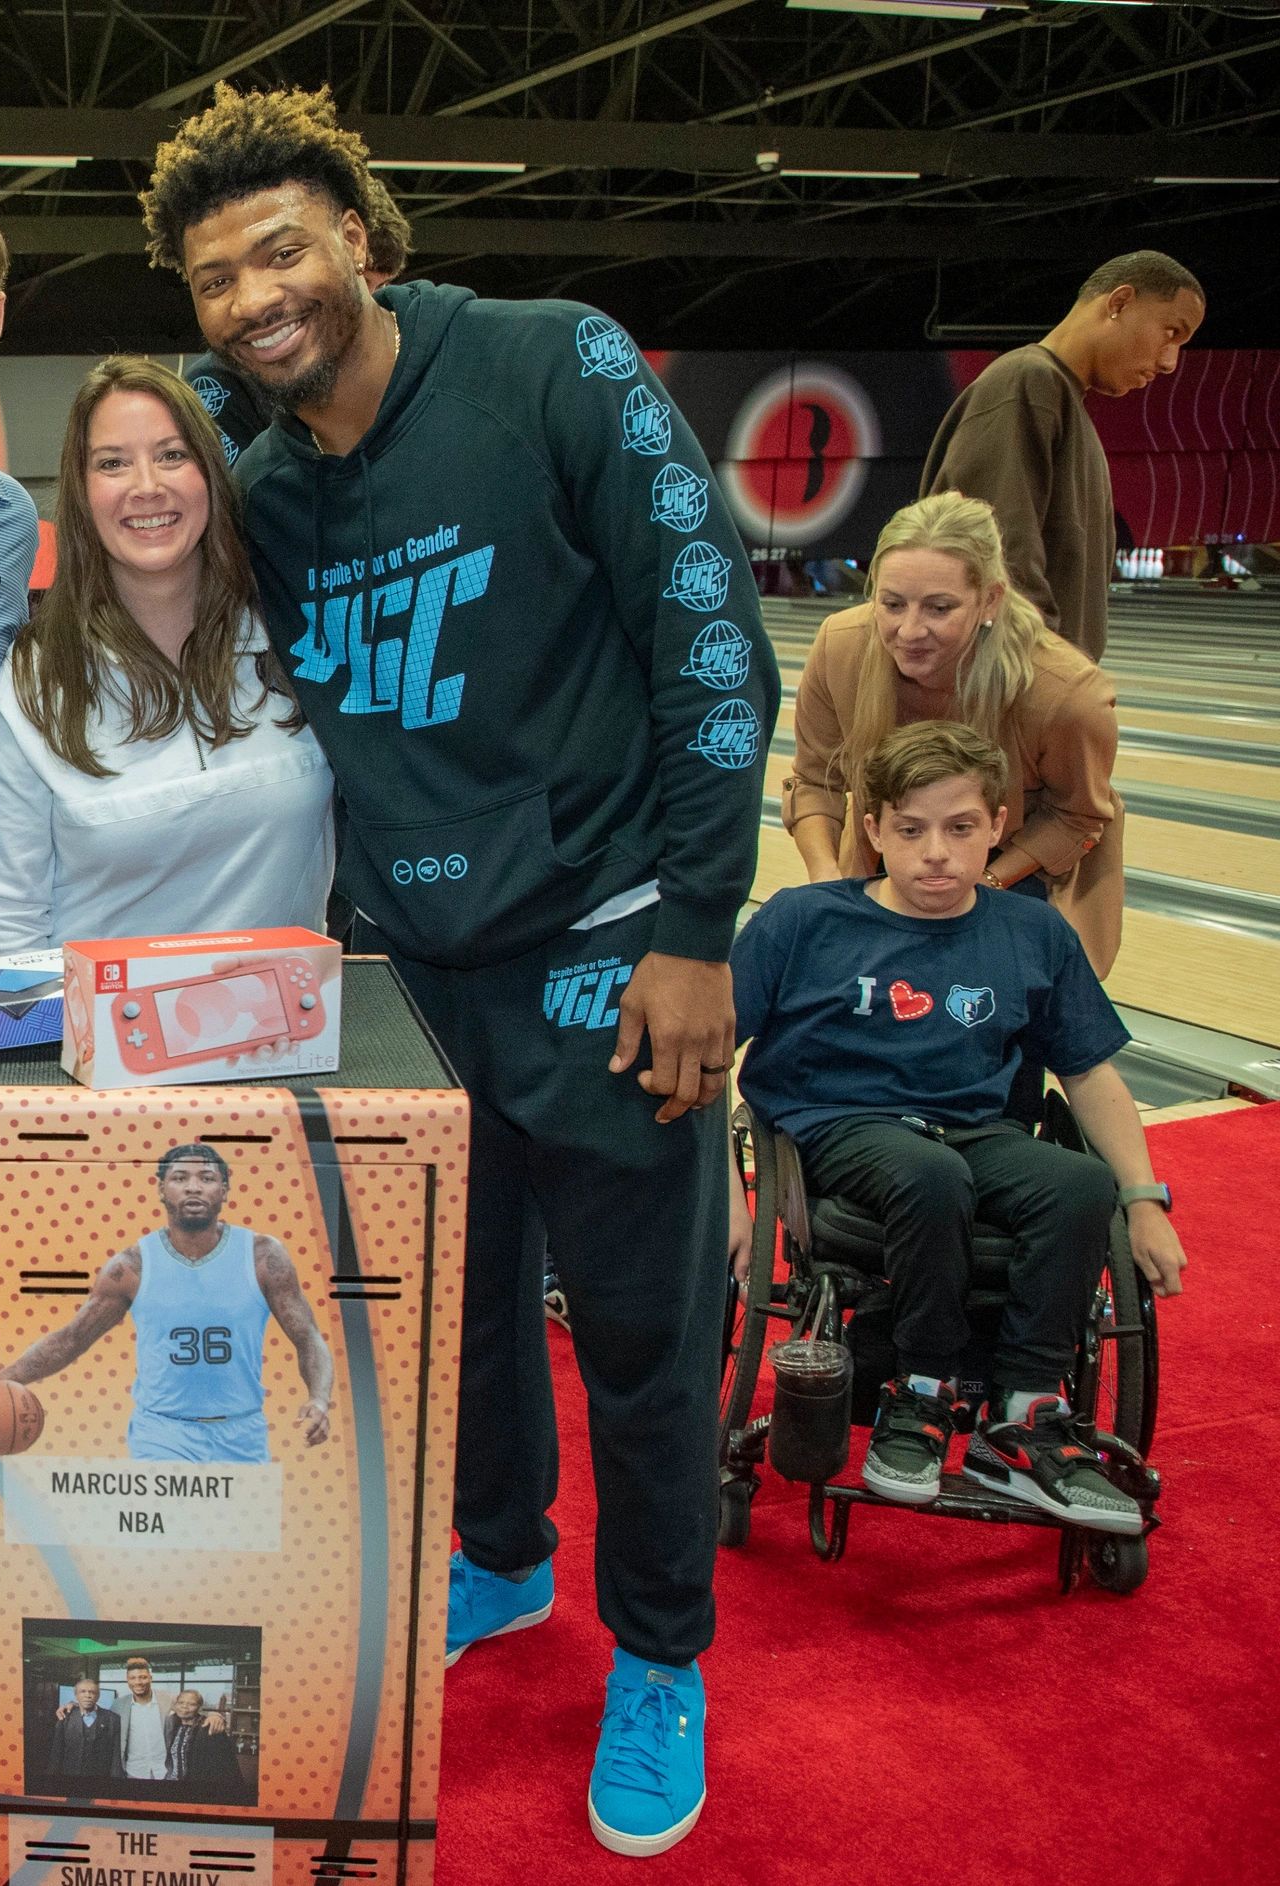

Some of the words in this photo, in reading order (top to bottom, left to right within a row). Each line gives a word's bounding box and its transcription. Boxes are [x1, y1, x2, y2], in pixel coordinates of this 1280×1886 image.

[307, 561, 352, 593] Dspite
[388, 547, 403, 570] or
[406, 523, 461, 563] Gender
[543, 965, 633, 1030] YGC
[852, 976, 877, 1016] I
[297, 1053, 336, 1069] Lite
[169, 1326, 232, 1365] 36
[51, 1472, 148, 1496] MARCUS
[154, 1475, 234, 1498] SMART
[119, 1511, 165, 1533] NBA
[116, 1832, 158, 1856] THE
[61, 1866, 136, 1886] SMART
